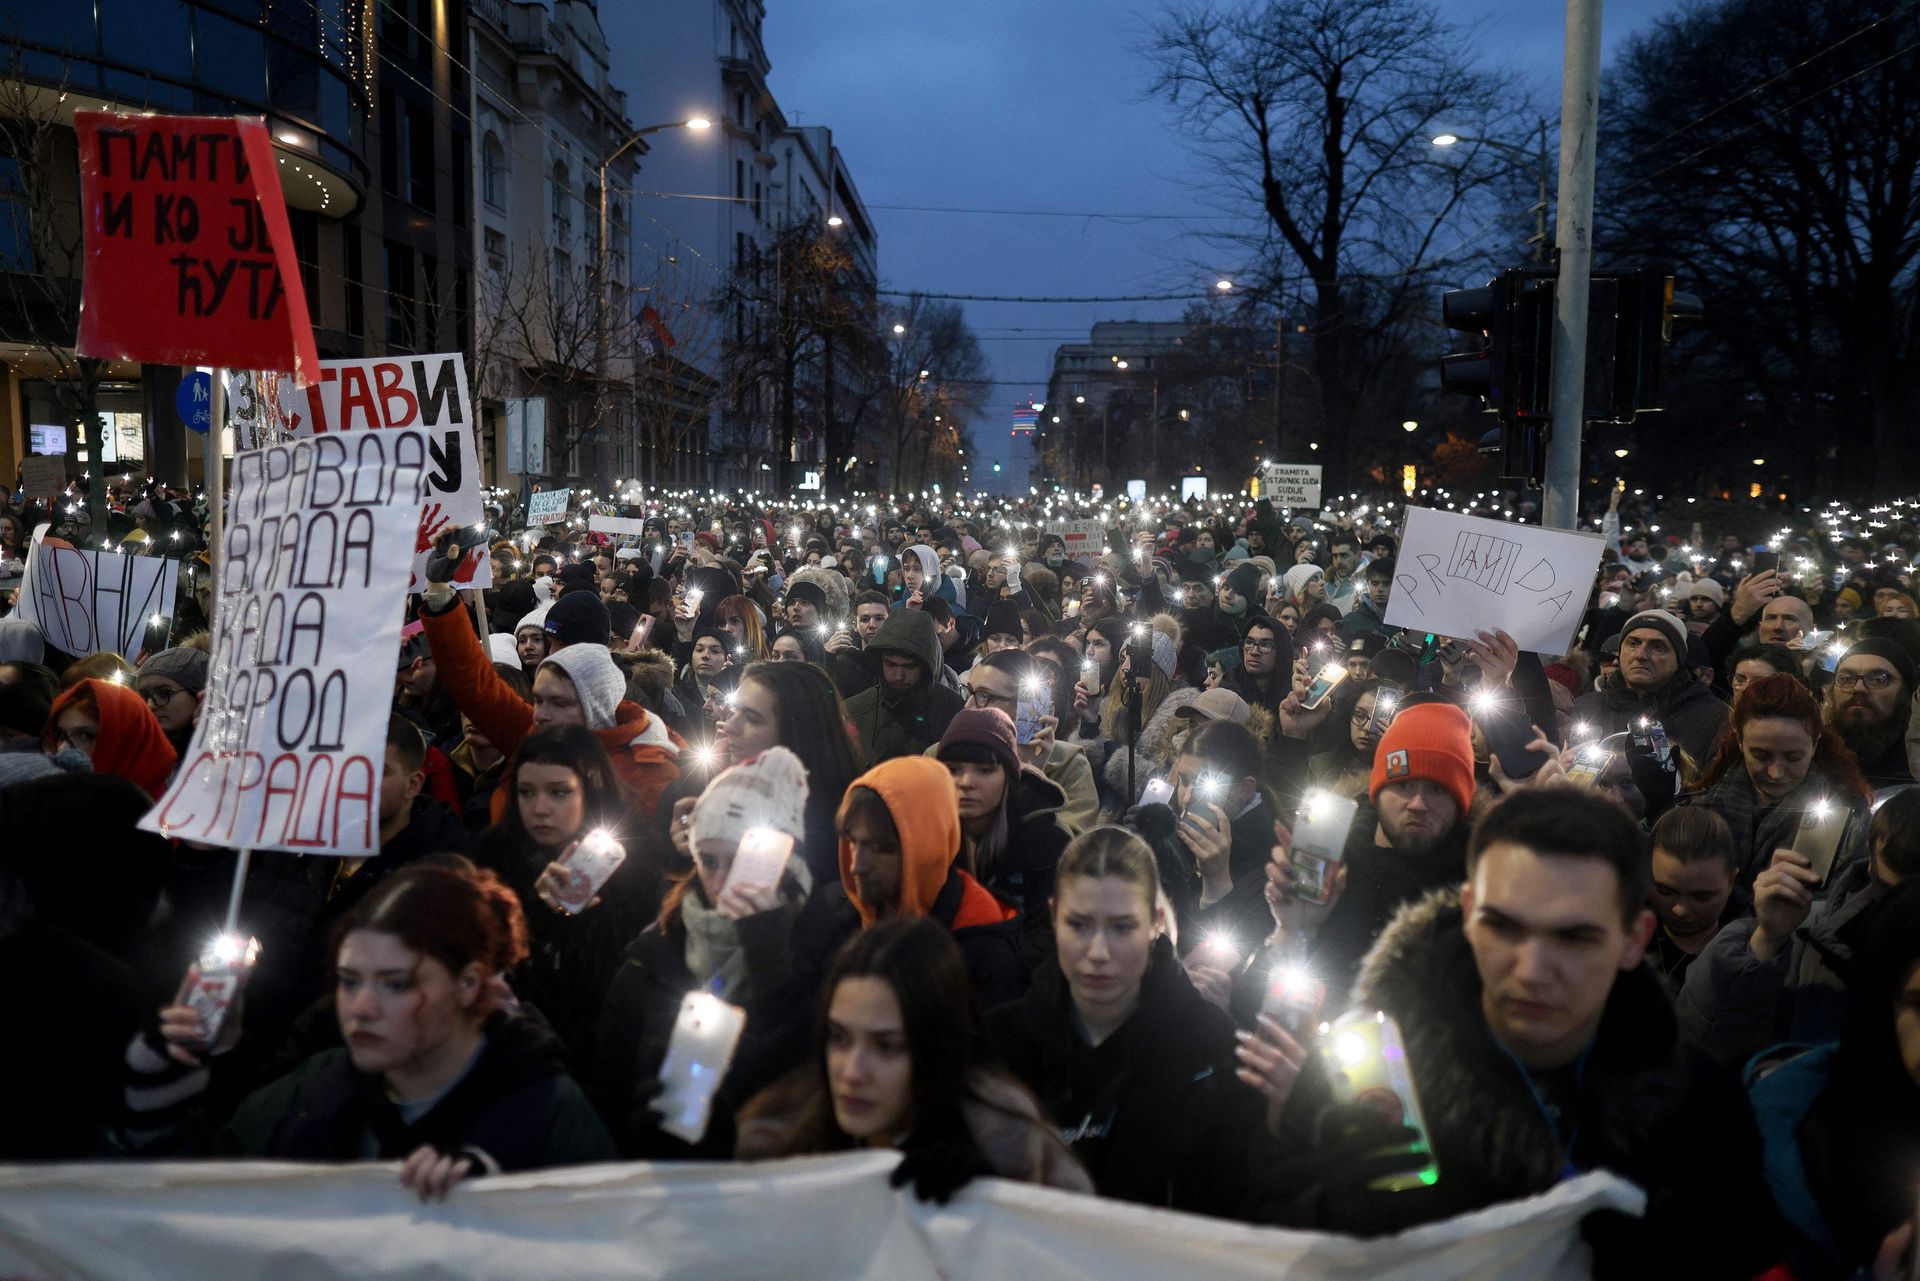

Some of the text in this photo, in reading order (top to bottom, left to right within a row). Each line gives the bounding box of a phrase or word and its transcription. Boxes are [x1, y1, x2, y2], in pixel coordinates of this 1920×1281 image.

[103, 192, 133, 239] И
[154, 194, 200, 245] КО
[234, 431, 425, 524] ПРАВДА
[1274, 468, 1310, 476] SRAMOTA
[217, 592, 325, 667] КАДА
[198, 667, 347, 752] НАРОД
[159, 752, 375, 848] СТРАДА
